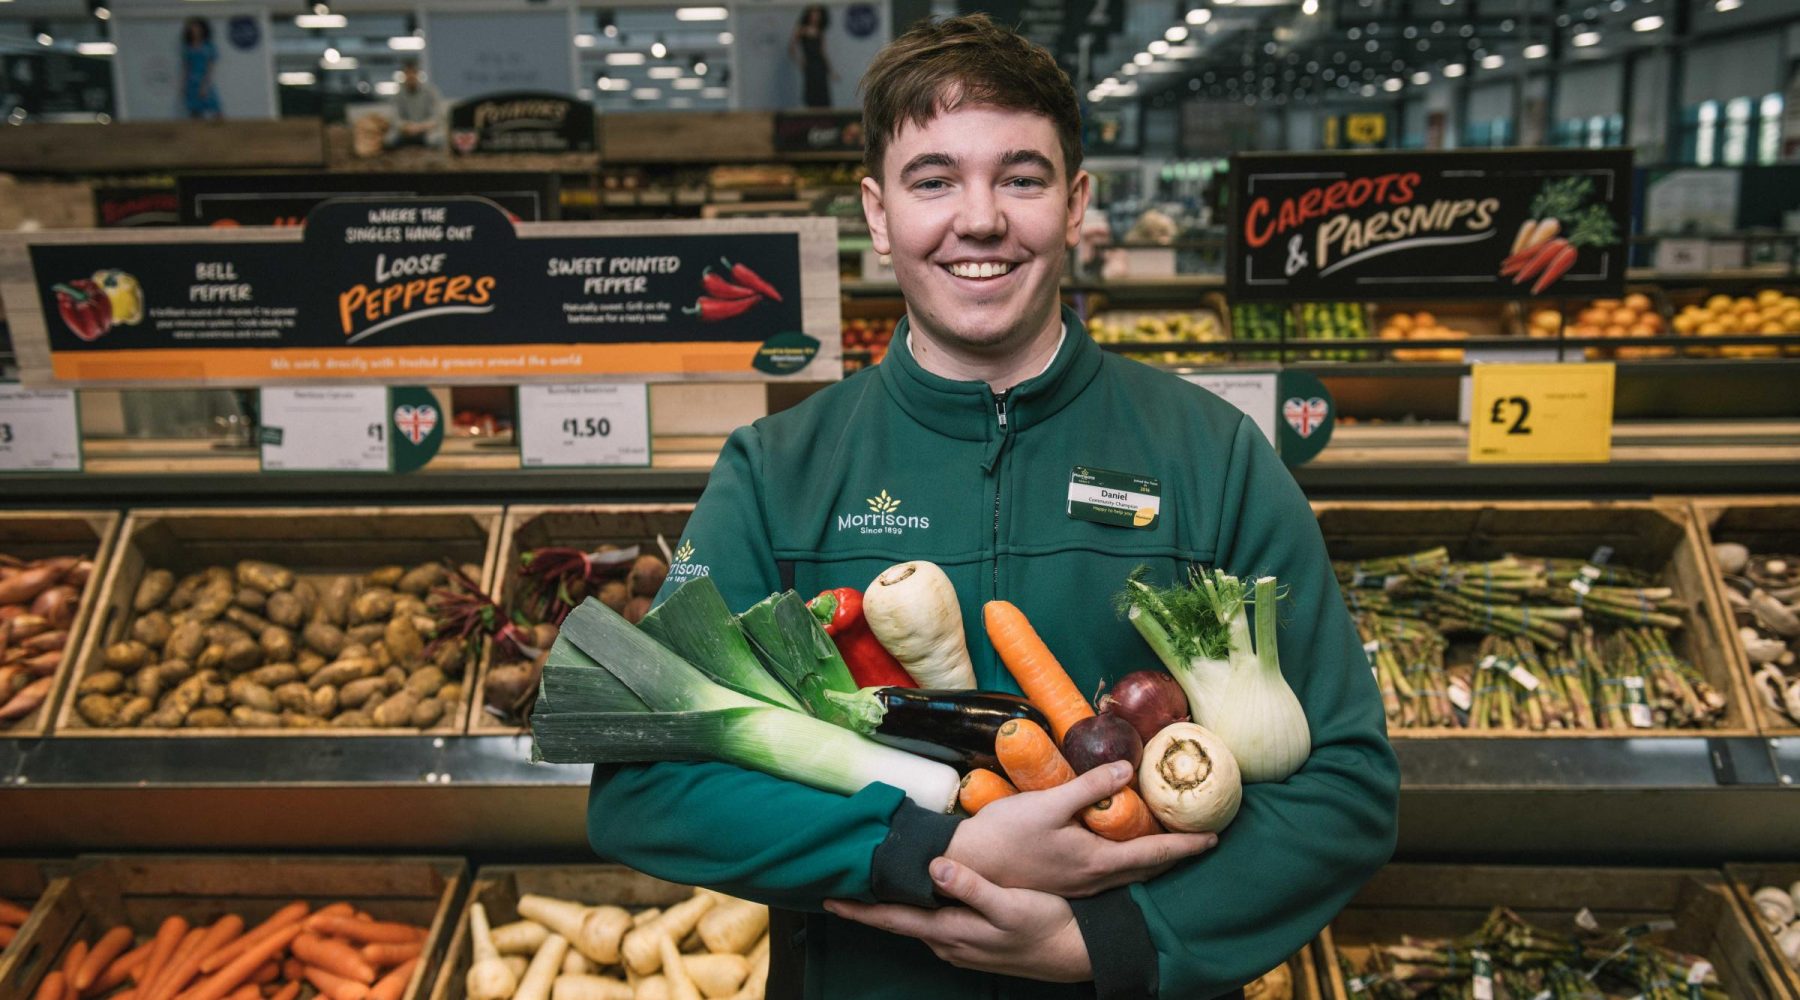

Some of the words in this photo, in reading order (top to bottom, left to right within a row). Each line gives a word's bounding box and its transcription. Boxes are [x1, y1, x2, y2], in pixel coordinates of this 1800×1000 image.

[368, 208, 417, 224] WHERE
[420, 207, 447, 223] THE
[1245, 172, 1421, 247] CARROTS
[345, 226, 402, 243] SINGLES
[404, 225, 443, 241] HANG
[446, 225, 475, 241] OUT
[1285, 234, 1308, 276] &
[1316, 198, 1500, 268] PARSNIPS
[195, 262, 238, 281] BELL
[375, 253, 447, 283] LOOSE
[547, 257, 605, 276] SWEET
[609, 256, 681, 274] POINTED
[189, 283, 253, 302] PEPPER
[584, 276, 648, 295] PEPPER
[339, 275, 497, 336] PEPPERS
[563, 301, 597, 313] Naturally
[656, 300, 671, 311] the
[567, 313, 604, 324] barbecue
[605, 312, 617, 323] for
[625, 313, 645, 324] tasty
[293, 358, 320, 369] work
[326, 357, 368, 371] directly
[371, 356, 394, 369] with
[399, 356, 438, 369] trusted
[441, 357, 484, 370] growers
[488, 355, 525, 368] around
[528, 355, 546, 367] the
[550, 354, 582, 367] world
[1490, 396, 1533, 436] £2
[367, 423, 383, 442] £1
[563, 417, 611, 437] £1.50
[1088, 496, 1115, 507] Community
[1115, 501, 1139, 510] Champion
[1101, 489, 1128, 501] Daniel
[838, 510, 930, 532] Morrisons
[860, 526, 882, 535] Since
[884, 526, 903, 535] 1899
